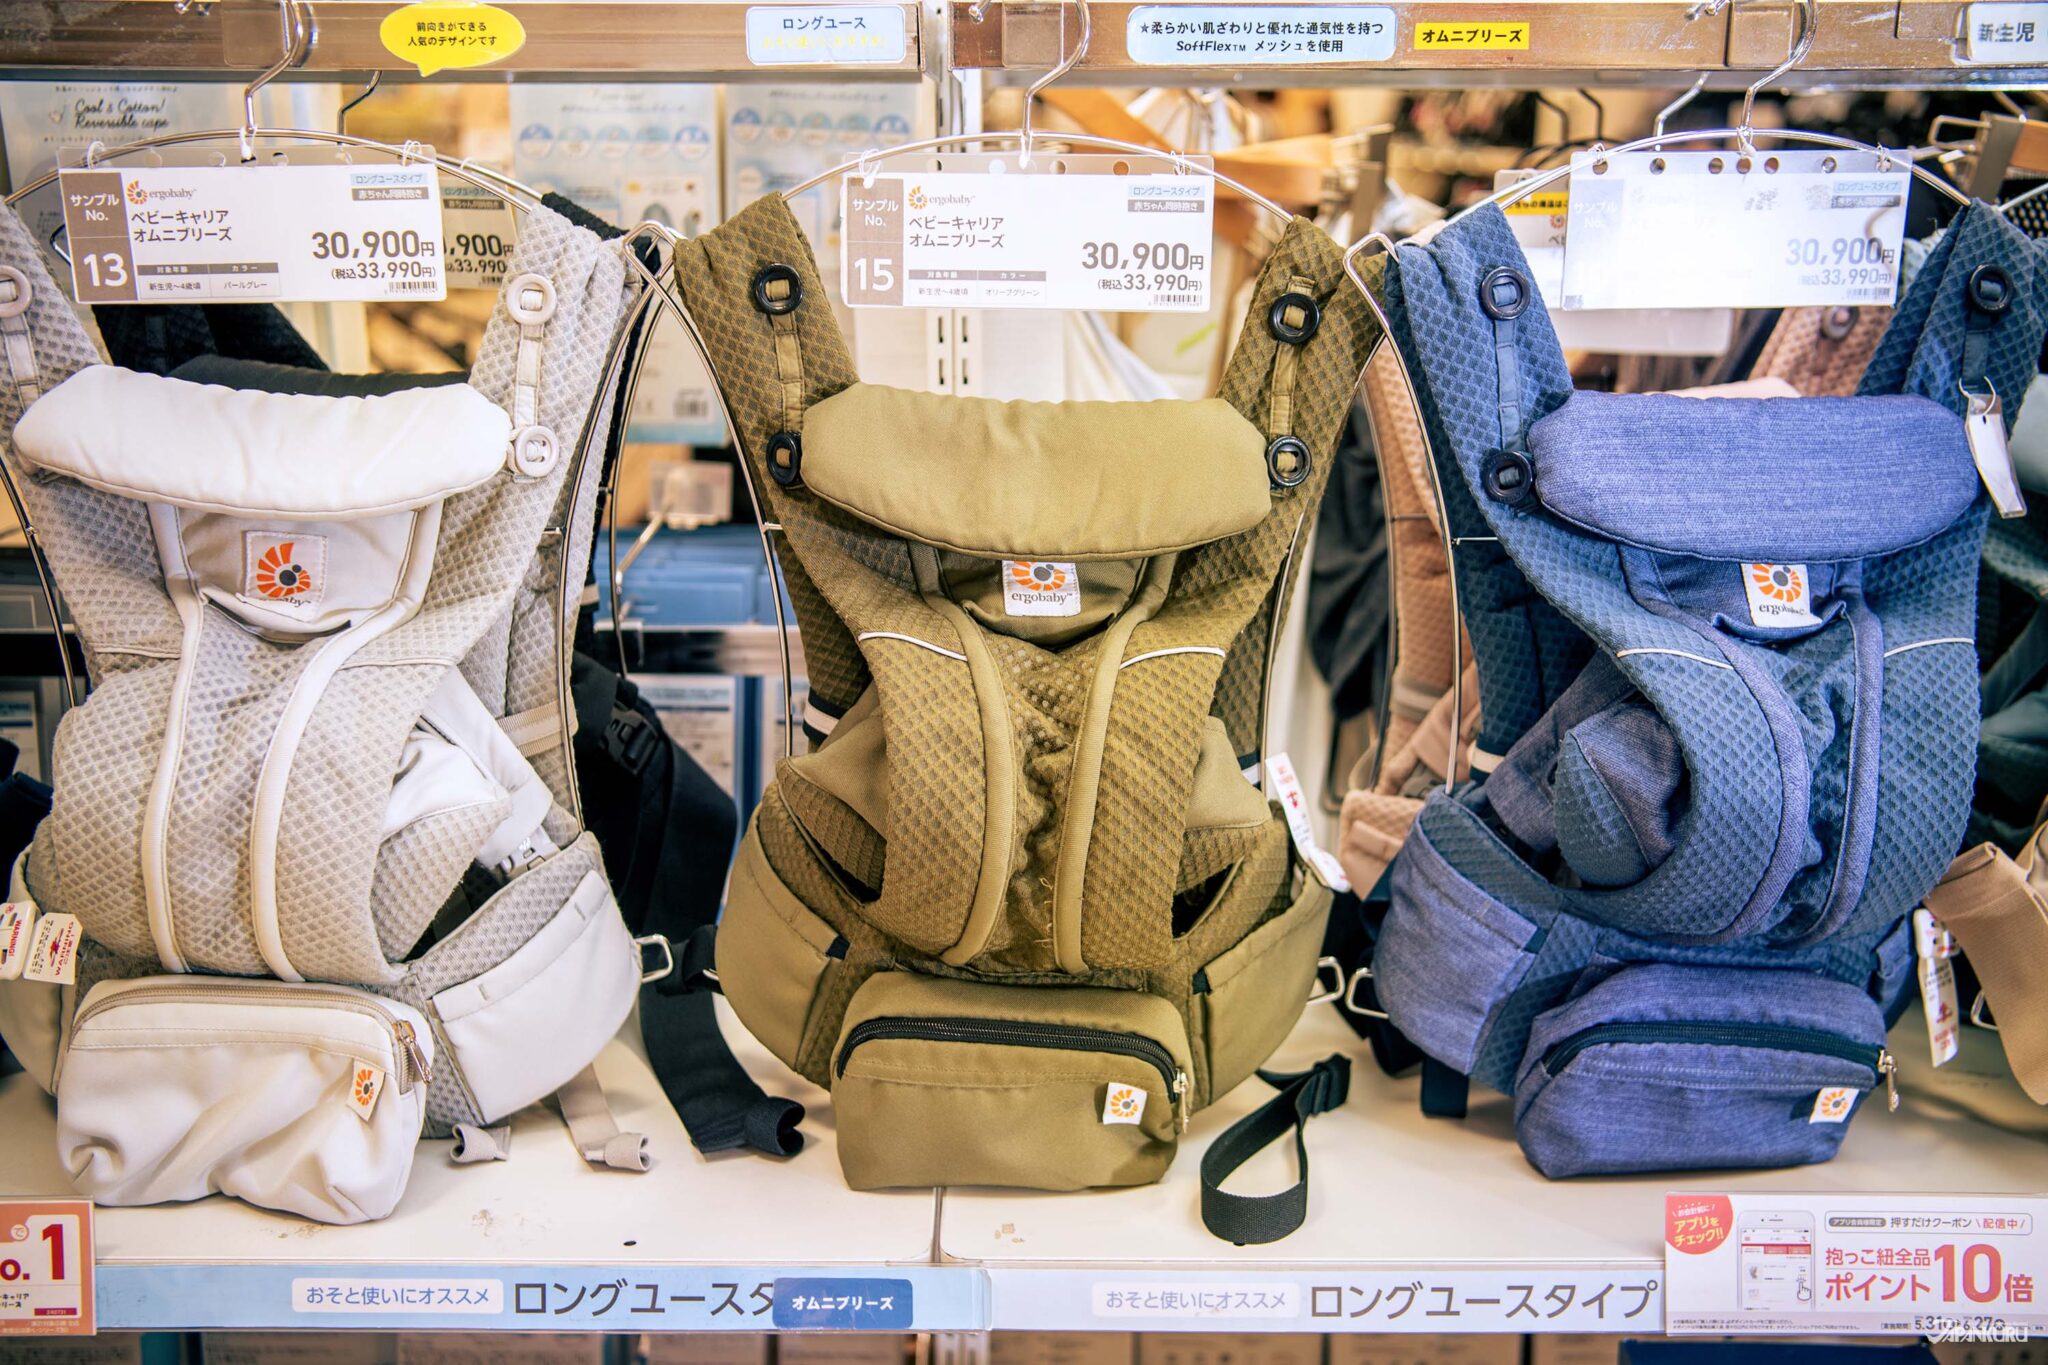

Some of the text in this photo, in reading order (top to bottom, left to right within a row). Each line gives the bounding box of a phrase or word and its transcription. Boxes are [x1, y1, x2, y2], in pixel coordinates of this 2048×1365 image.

[416, 22, 487, 32] 前向きができる
[783, 16, 866, 30] ロングユース
[1422, 29, 1522, 44] オムニブリーズ
[1978, 22, 2035, 42] 新生児
[408, 36, 498, 47] 人気のデザインです
[1255, 40, 1343, 52] メッシュを使用
[75, 98, 103, 114] Cool
[356, 174, 422, 184] ロングユースタイプ
[70, 193, 120, 207] サンプル
[852, 199, 899, 212] サンプル
[86, 210, 109, 221] No.
[131, 210, 229, 224] ベビーキャリア
[865, 215, 887, 226] No.
[909, 216, 1004, 231] ベビーキャリア
[134, 227, 232, 242] オムニブリーズ
[909, 234, 1005, 248] オムニブリーズ
[312, 231, 435, 259] 30,900円
[1786, 237, 1895, 266] 30,900円
[1081, 242, 1204, 271] 30,900円
[83, 253, 128, 287] 13
[854, 258, 894, 291] 15
[1674, 1216, 1720, 1233] アプリを
[1890, 1217, 1972, 1228] 押すだけクーポン
[1983, 1218, 2018, 1229] 配信中
[1825, 1248, 1931, 1266] 抱っこ紐全品
[1825, 1271, 1932, 1301] ポイント
[306, 1286, 490, 1305] おそと使いにオススメ
[792, 1295, 894, 1311] オムニブリーズ
[1106, 1290, 1286, 1310] おそと使いにオススメ
[1311, 1279, 1658, 1319] ロングユースタイプ
